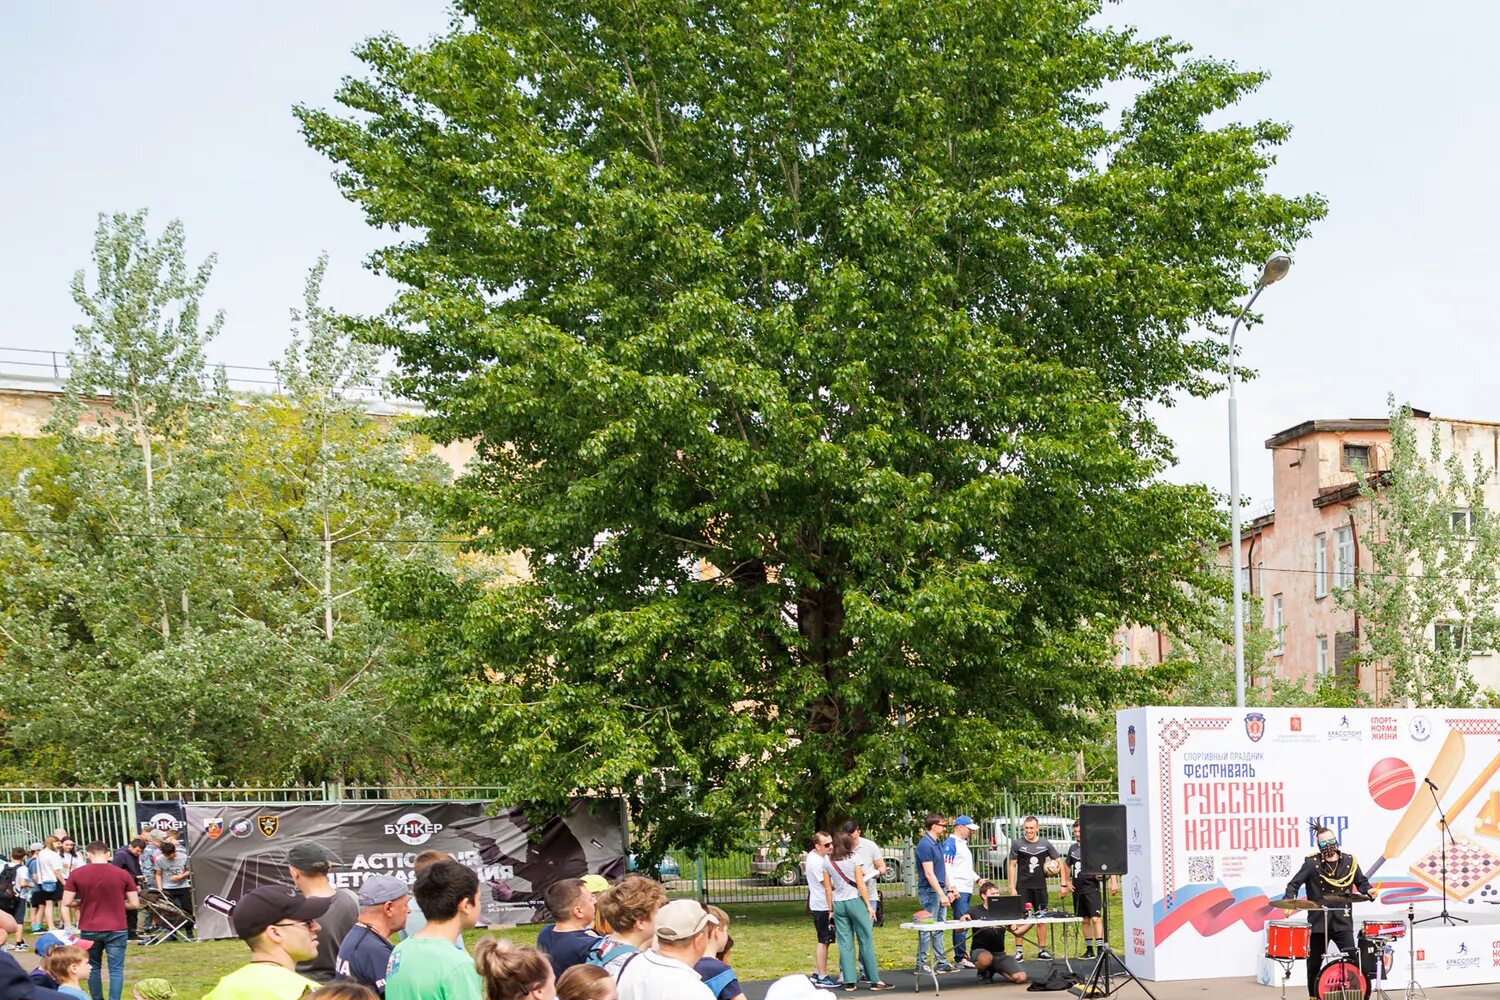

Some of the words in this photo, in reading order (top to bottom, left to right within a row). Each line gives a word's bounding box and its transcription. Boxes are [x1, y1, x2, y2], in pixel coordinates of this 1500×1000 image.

[1184, 752, 1229, 762] СПОРТИВНЫЙ
[1230, 752, 1264, 761] ПРАЗДНИК
[1184, 763, 1256, 778] ФЕСТИВАЛЬ
[1184, 782, 1284, 815] РУССКИХ
[384, 824, 443, 835] БУНКЕР
[1185, 817, 1299, 851] НАРОДНЫХ
[352, 853, 418, 870] ACTIO
[1446, 957, 1480, 965] КРАССПОРТ
